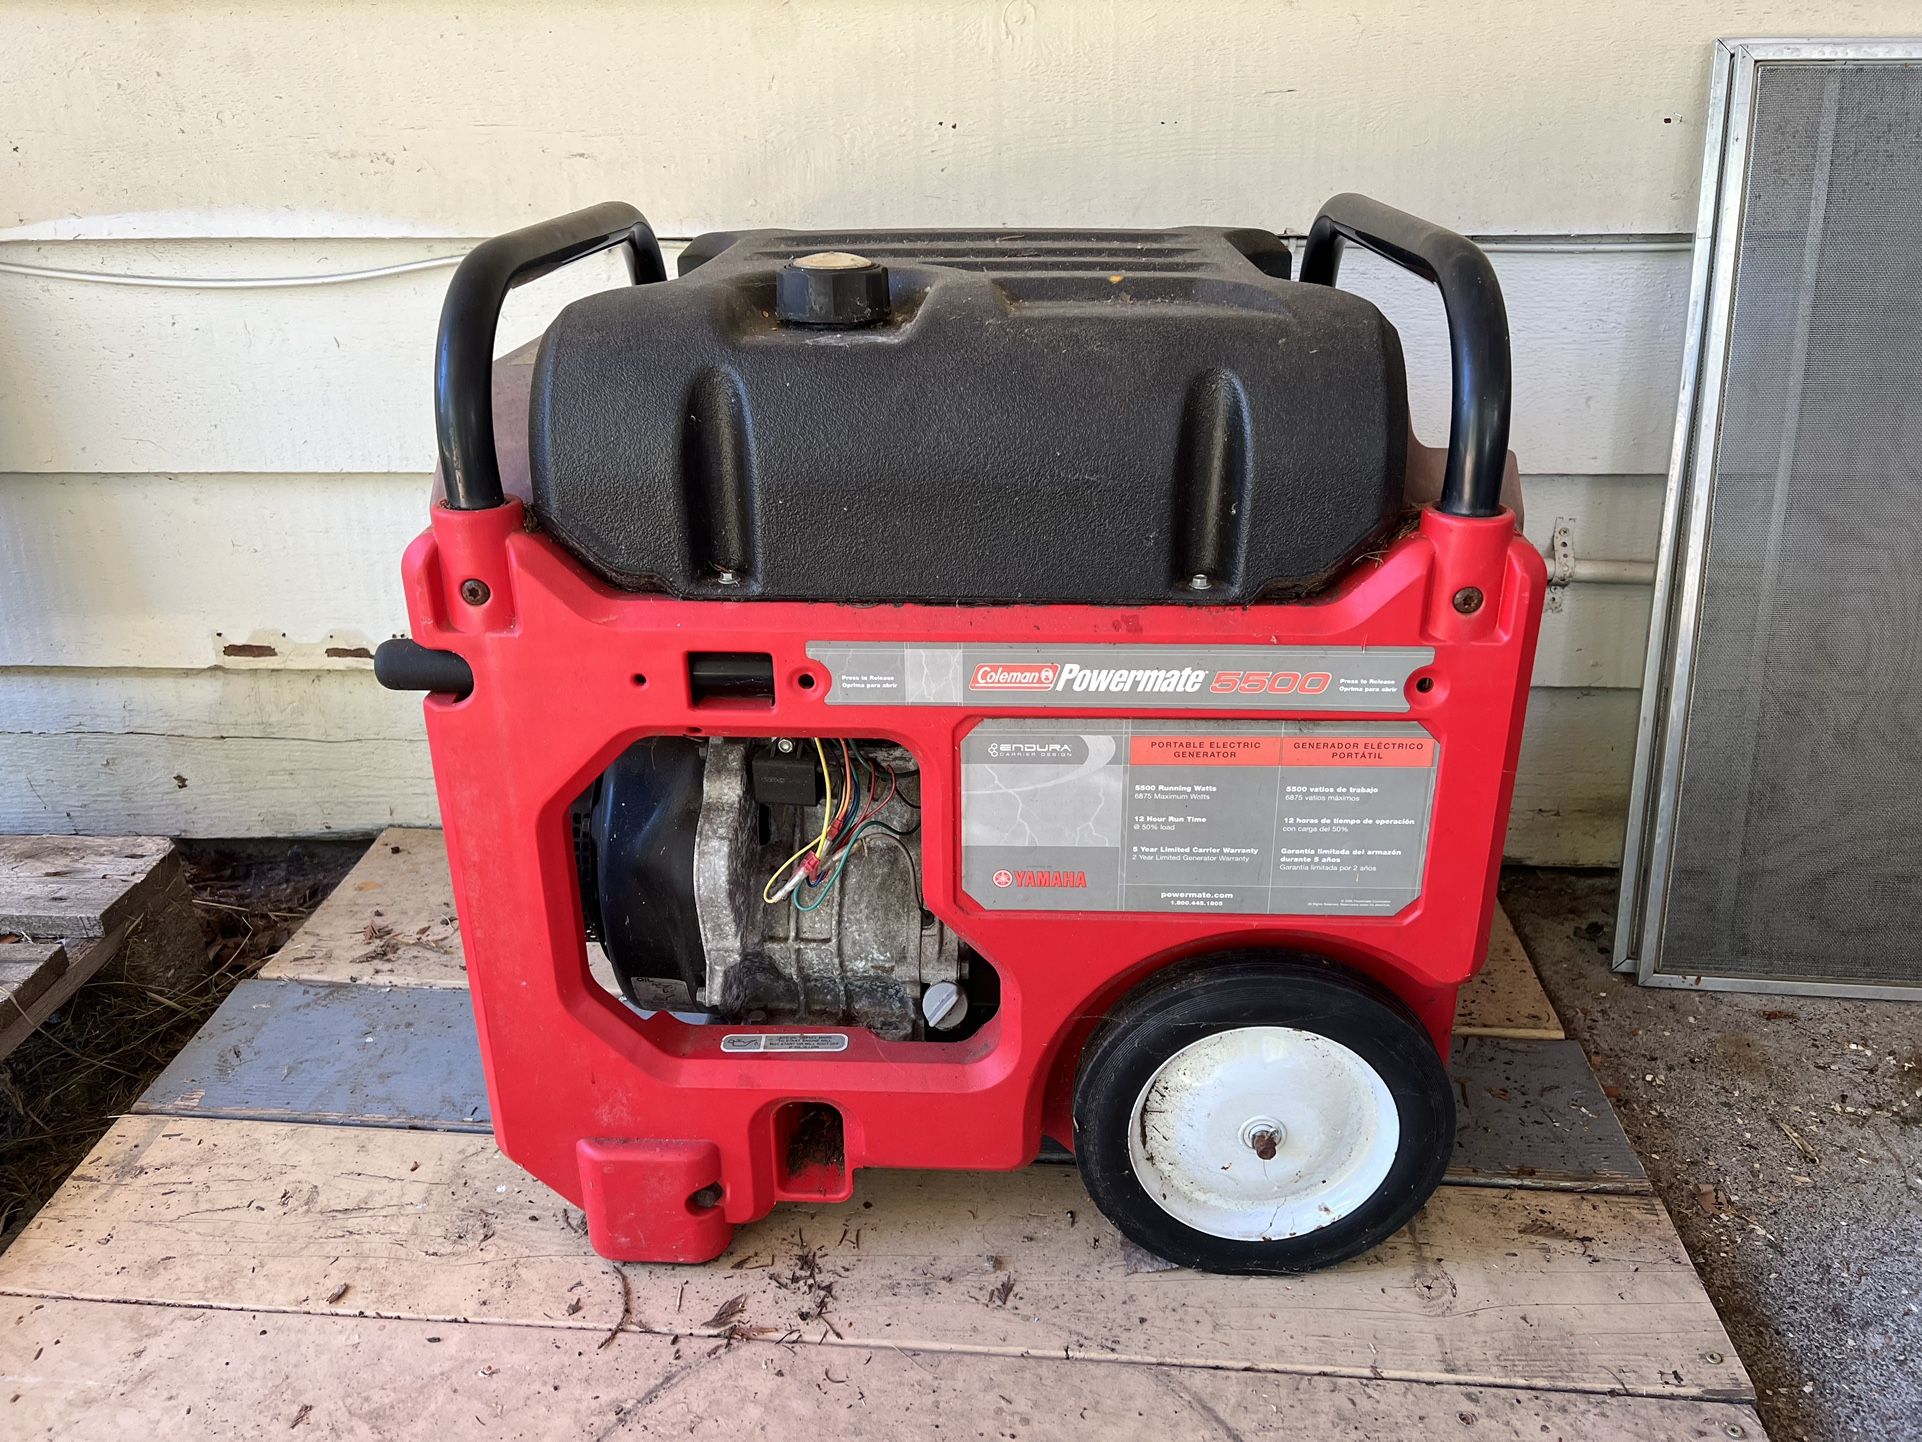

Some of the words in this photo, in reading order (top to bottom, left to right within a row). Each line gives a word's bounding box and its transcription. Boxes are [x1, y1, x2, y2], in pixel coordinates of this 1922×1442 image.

[977, 666, 1039, 684] Coleman
[1055, 663, 1206, 693] Powermate
[1209, 671, 1332, 695] 5500
[999, 744, 1072, 752] ENDURA
[1150, 741, 1205, 749] PORTABLE
[1209, 741, 1262, 749] ELECTRIC
[1293, 742, 1360, 750] GENERADOR
[1363, 741, 1424, 750] ELÉCTRICO
[1173, 751, 1237, 759] GENERATOR
[1331, 751, 1384, 760] PORTÁTIL
[1158, 785, 1192, 793] Running
[1349, 786, 1379, 794] trabajo
[1333, 818, 1361, 826] tiempo
[1375, 818, 1415, 826] operación
[1297, 826, 1318, 834] carga
[1222, 847, 1259, 855] Warranty
[1013, 871, 1087, 888] YAMAHA
[1160, 891, 1234, 899] powermate.com
